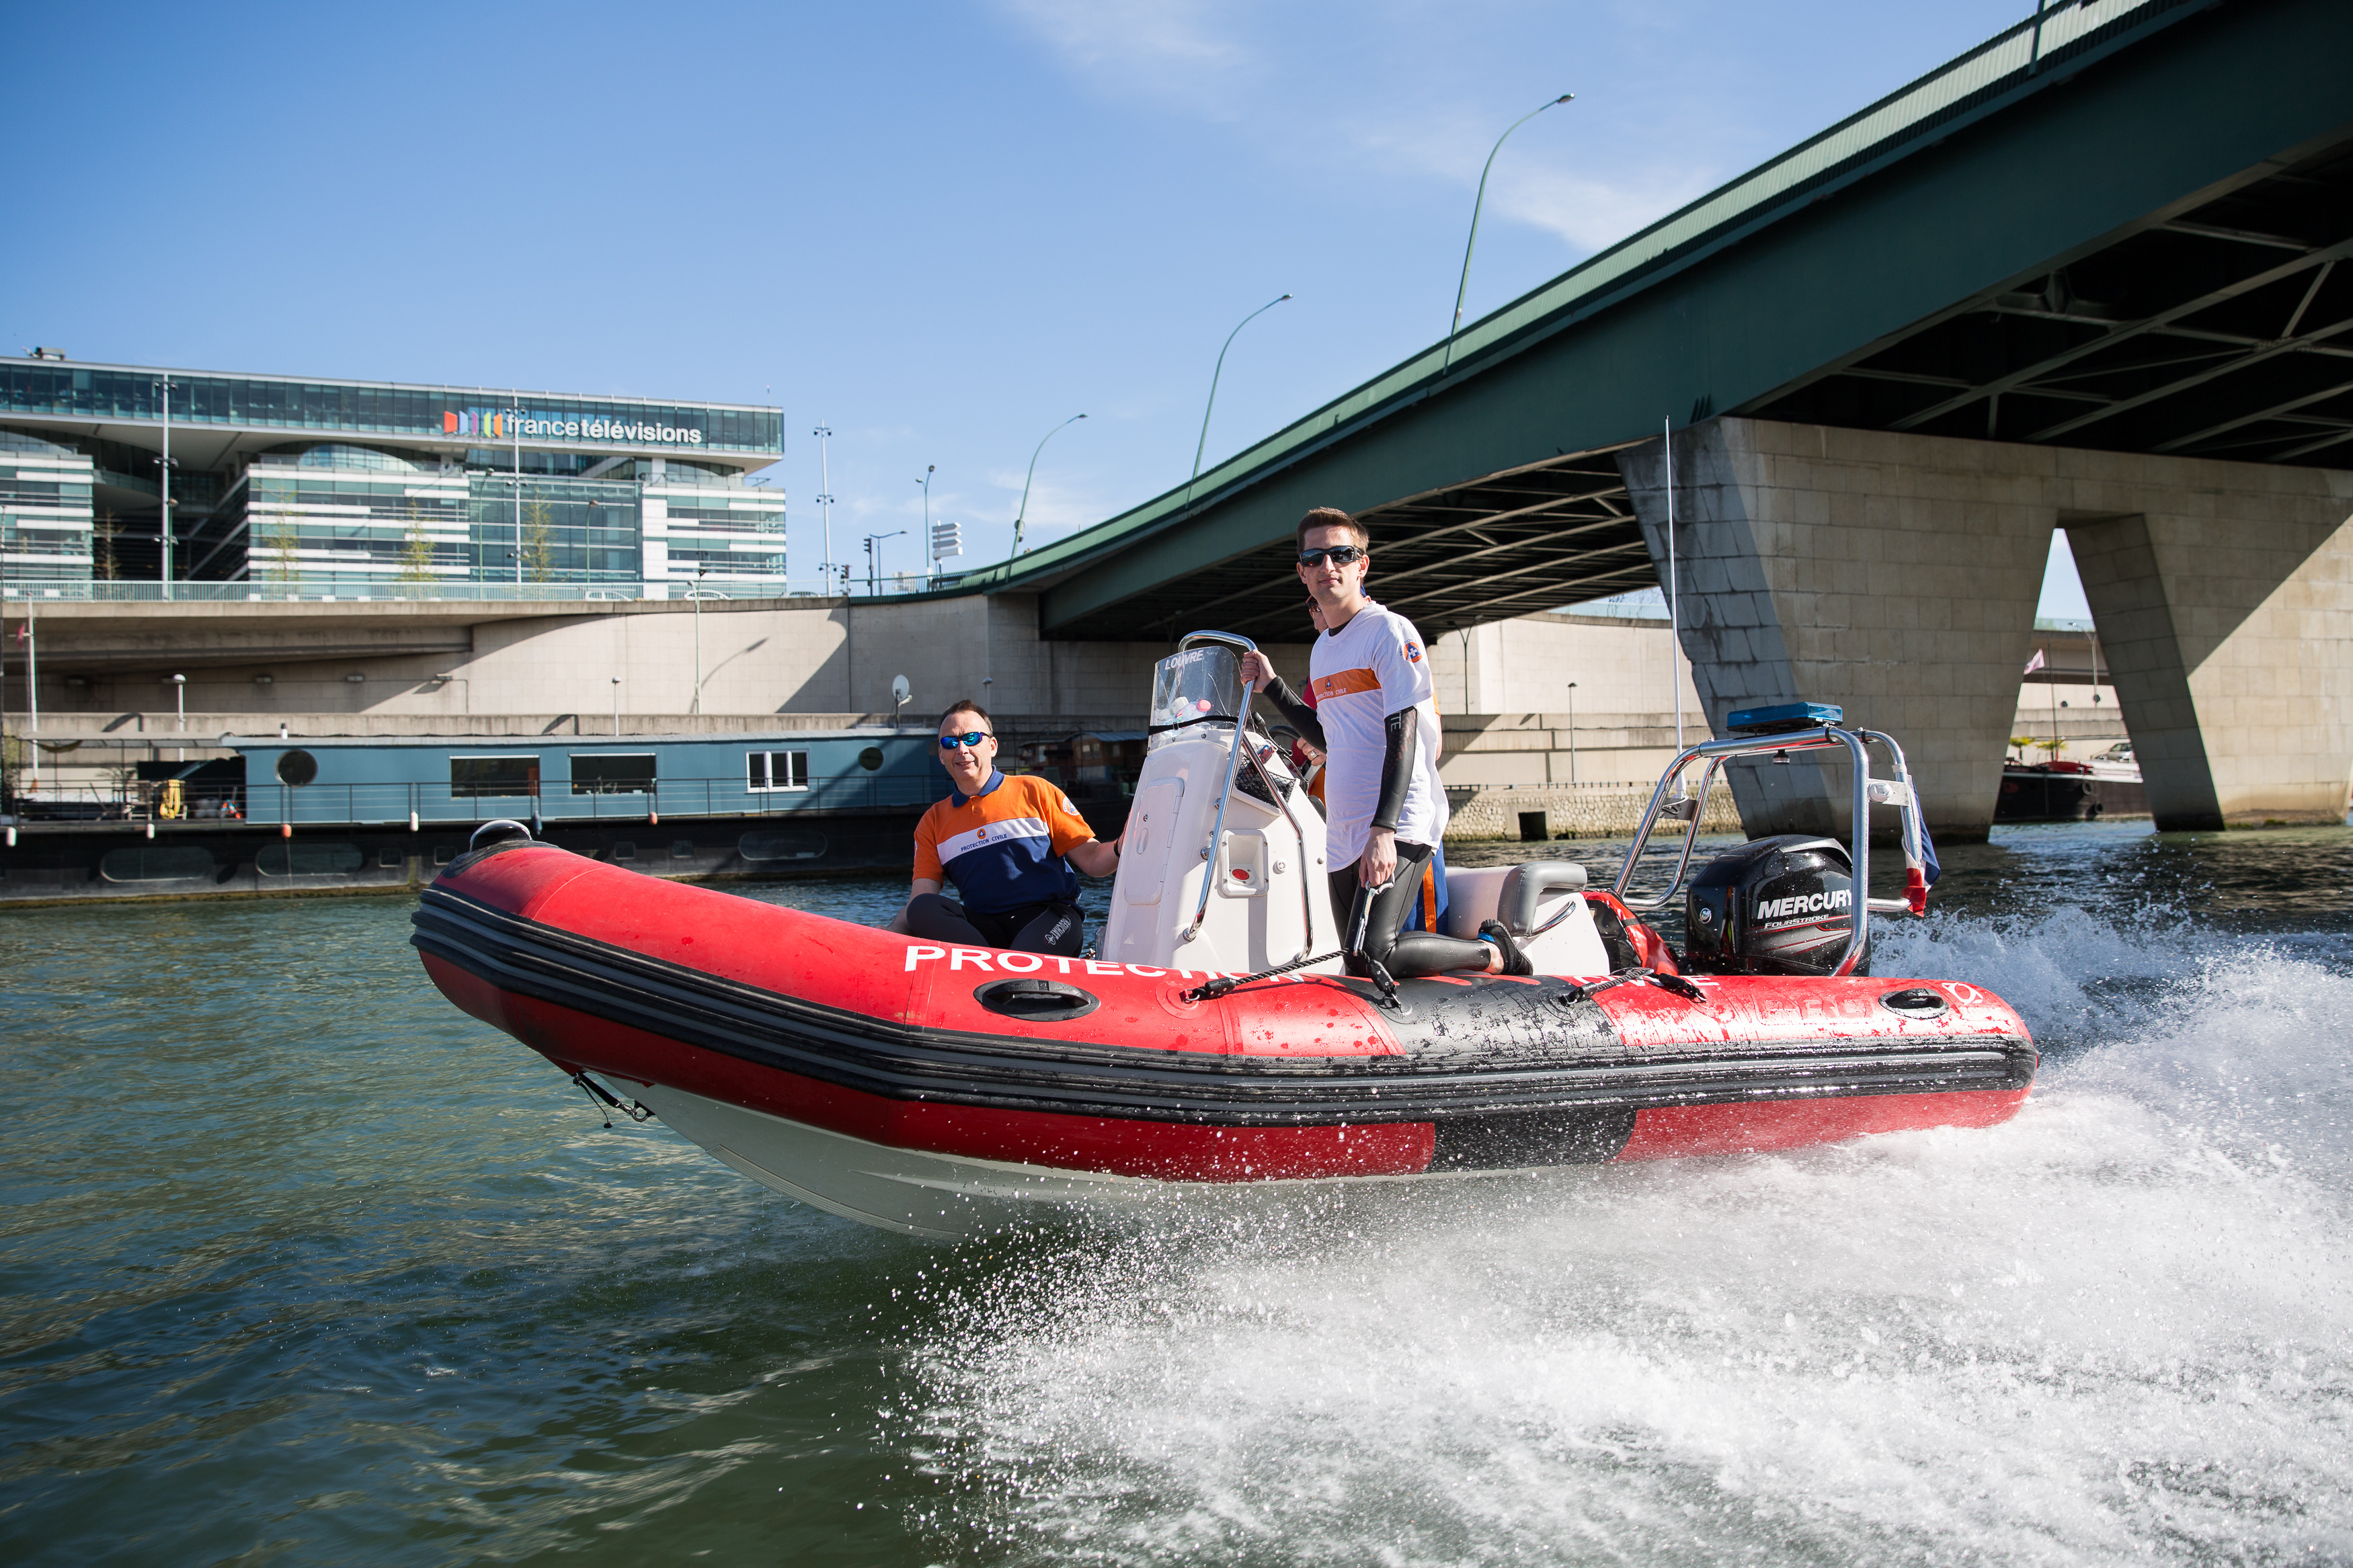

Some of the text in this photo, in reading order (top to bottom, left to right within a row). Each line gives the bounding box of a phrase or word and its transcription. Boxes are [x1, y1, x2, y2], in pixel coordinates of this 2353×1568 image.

[506, 414, 703, 444] france télévisions
[1164, 649, 1204, 670] LOUVRE
[961, 833, 1008, 852] PROTECTION CIVILE
[1049, 917, 1070, 940] BEUCHAT
[1764, 914, 1829, 929] FOURSTROKE
[1573, 975, 1720, 987] CIVIE
